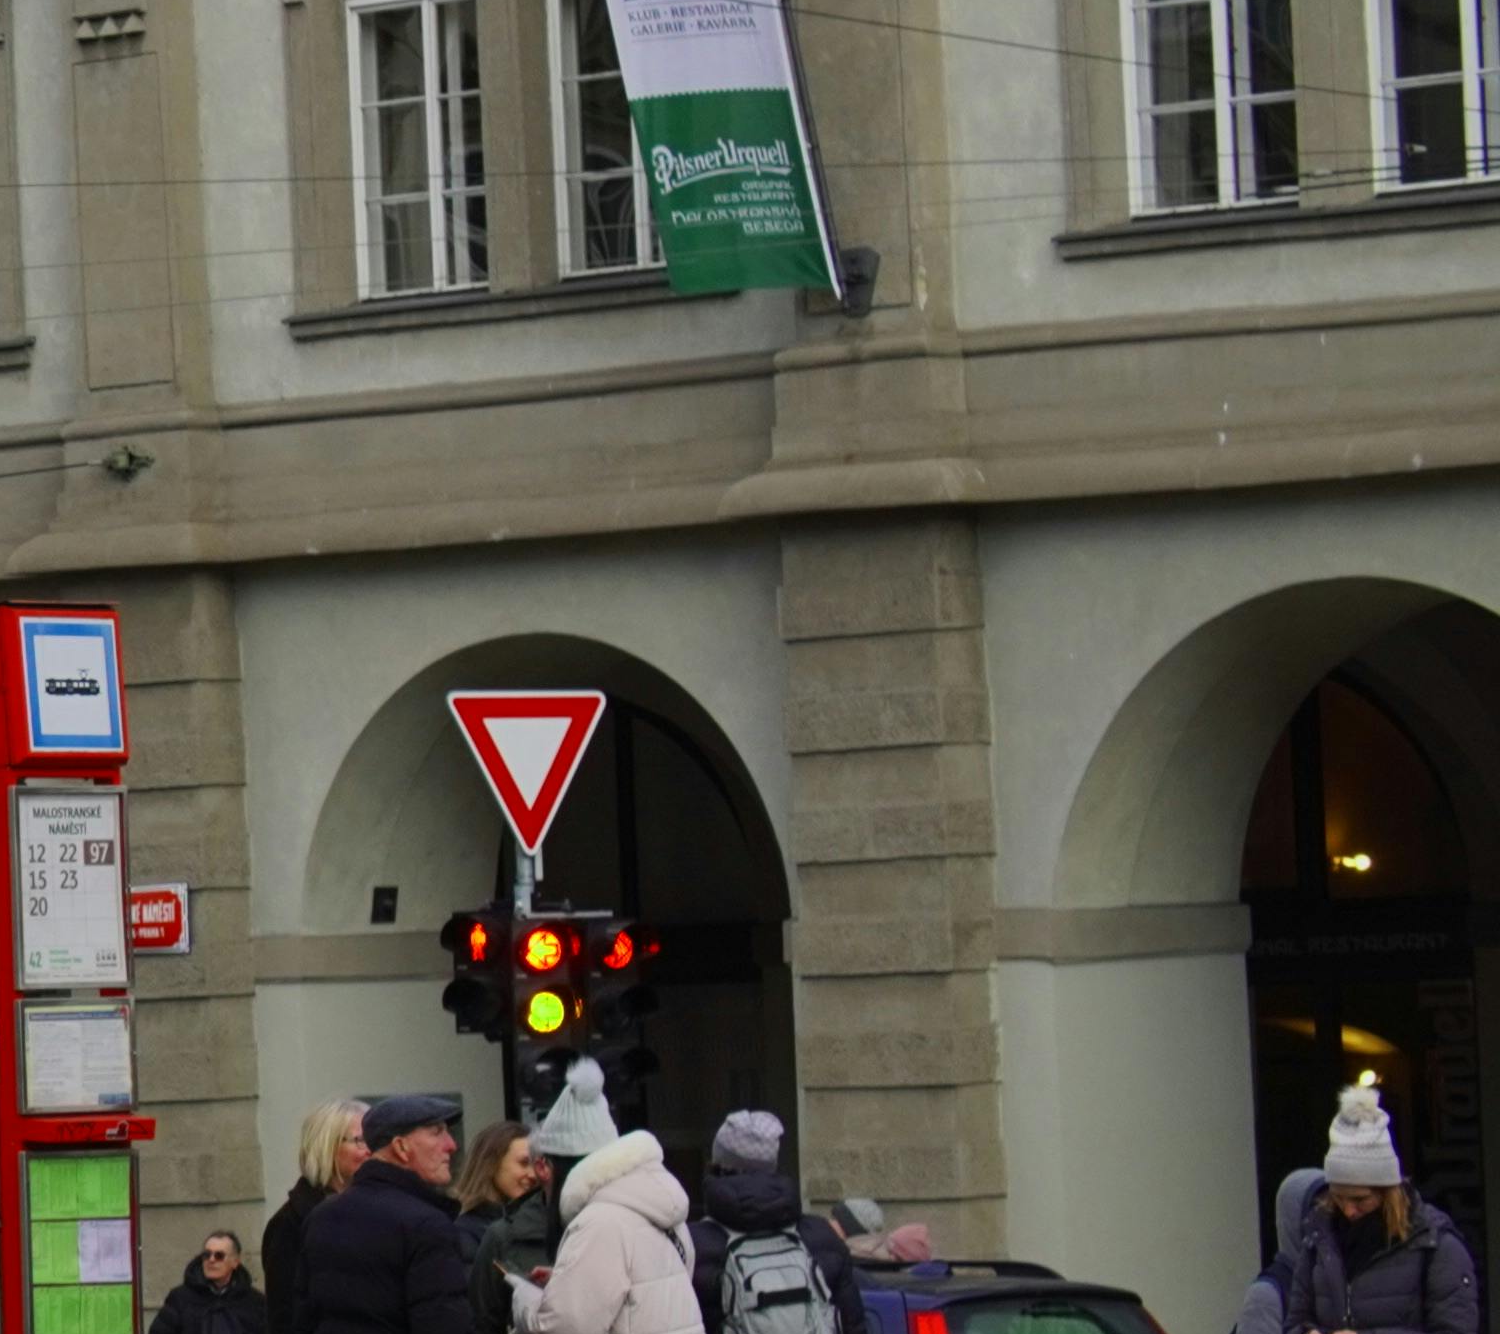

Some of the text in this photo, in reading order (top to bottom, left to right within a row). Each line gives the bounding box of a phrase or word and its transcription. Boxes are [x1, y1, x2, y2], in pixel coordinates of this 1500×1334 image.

[627, 0, 754, 22] KLUB RESTAURACE
[631, 15, 757, 37] GALERIE KAVÁRNA
[652, 137, 791, 195] Pilsner Urquell
[32, 806, 103, 819] MALOSTRANSKÉ
[48, 822, 88, 835] NÁMĚSTÍ
[28, 843, 110, 864] 12 22 97
[29, 870, 79, 890] 15 23
[29, 898, 49, 916] 20
[29, 951, 43, 968] 42
